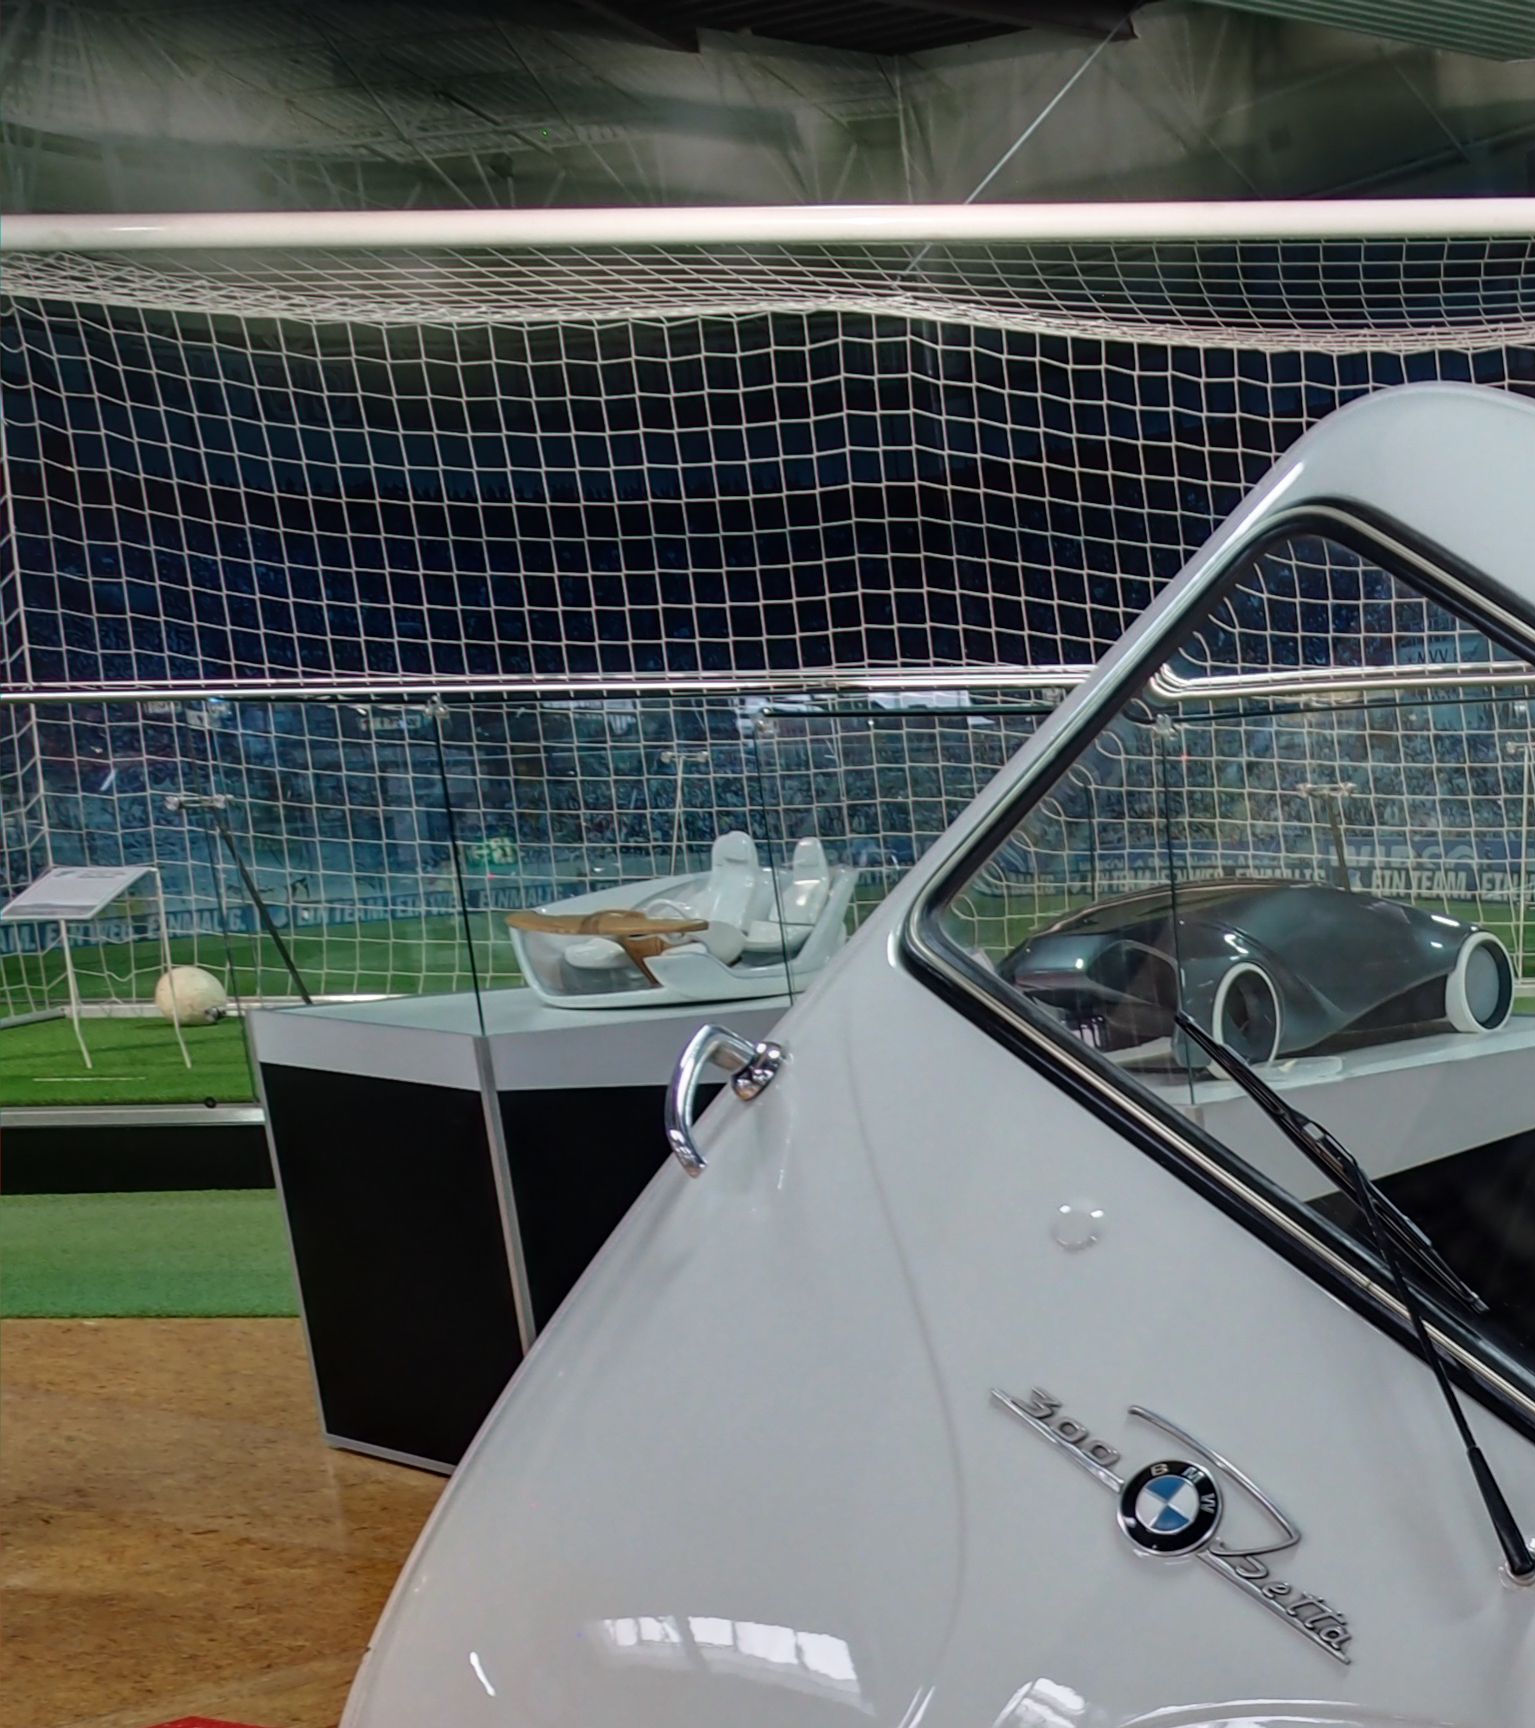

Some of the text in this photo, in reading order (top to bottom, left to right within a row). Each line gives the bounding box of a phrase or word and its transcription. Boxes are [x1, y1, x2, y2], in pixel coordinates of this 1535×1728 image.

[1371, 870, 1407, 898] EIN
[1413, 871, 1470, 900] TEAM.
[1011, 1385, 1122, 1469] 300
[1150, 1462, 1217, 1514] BMW
